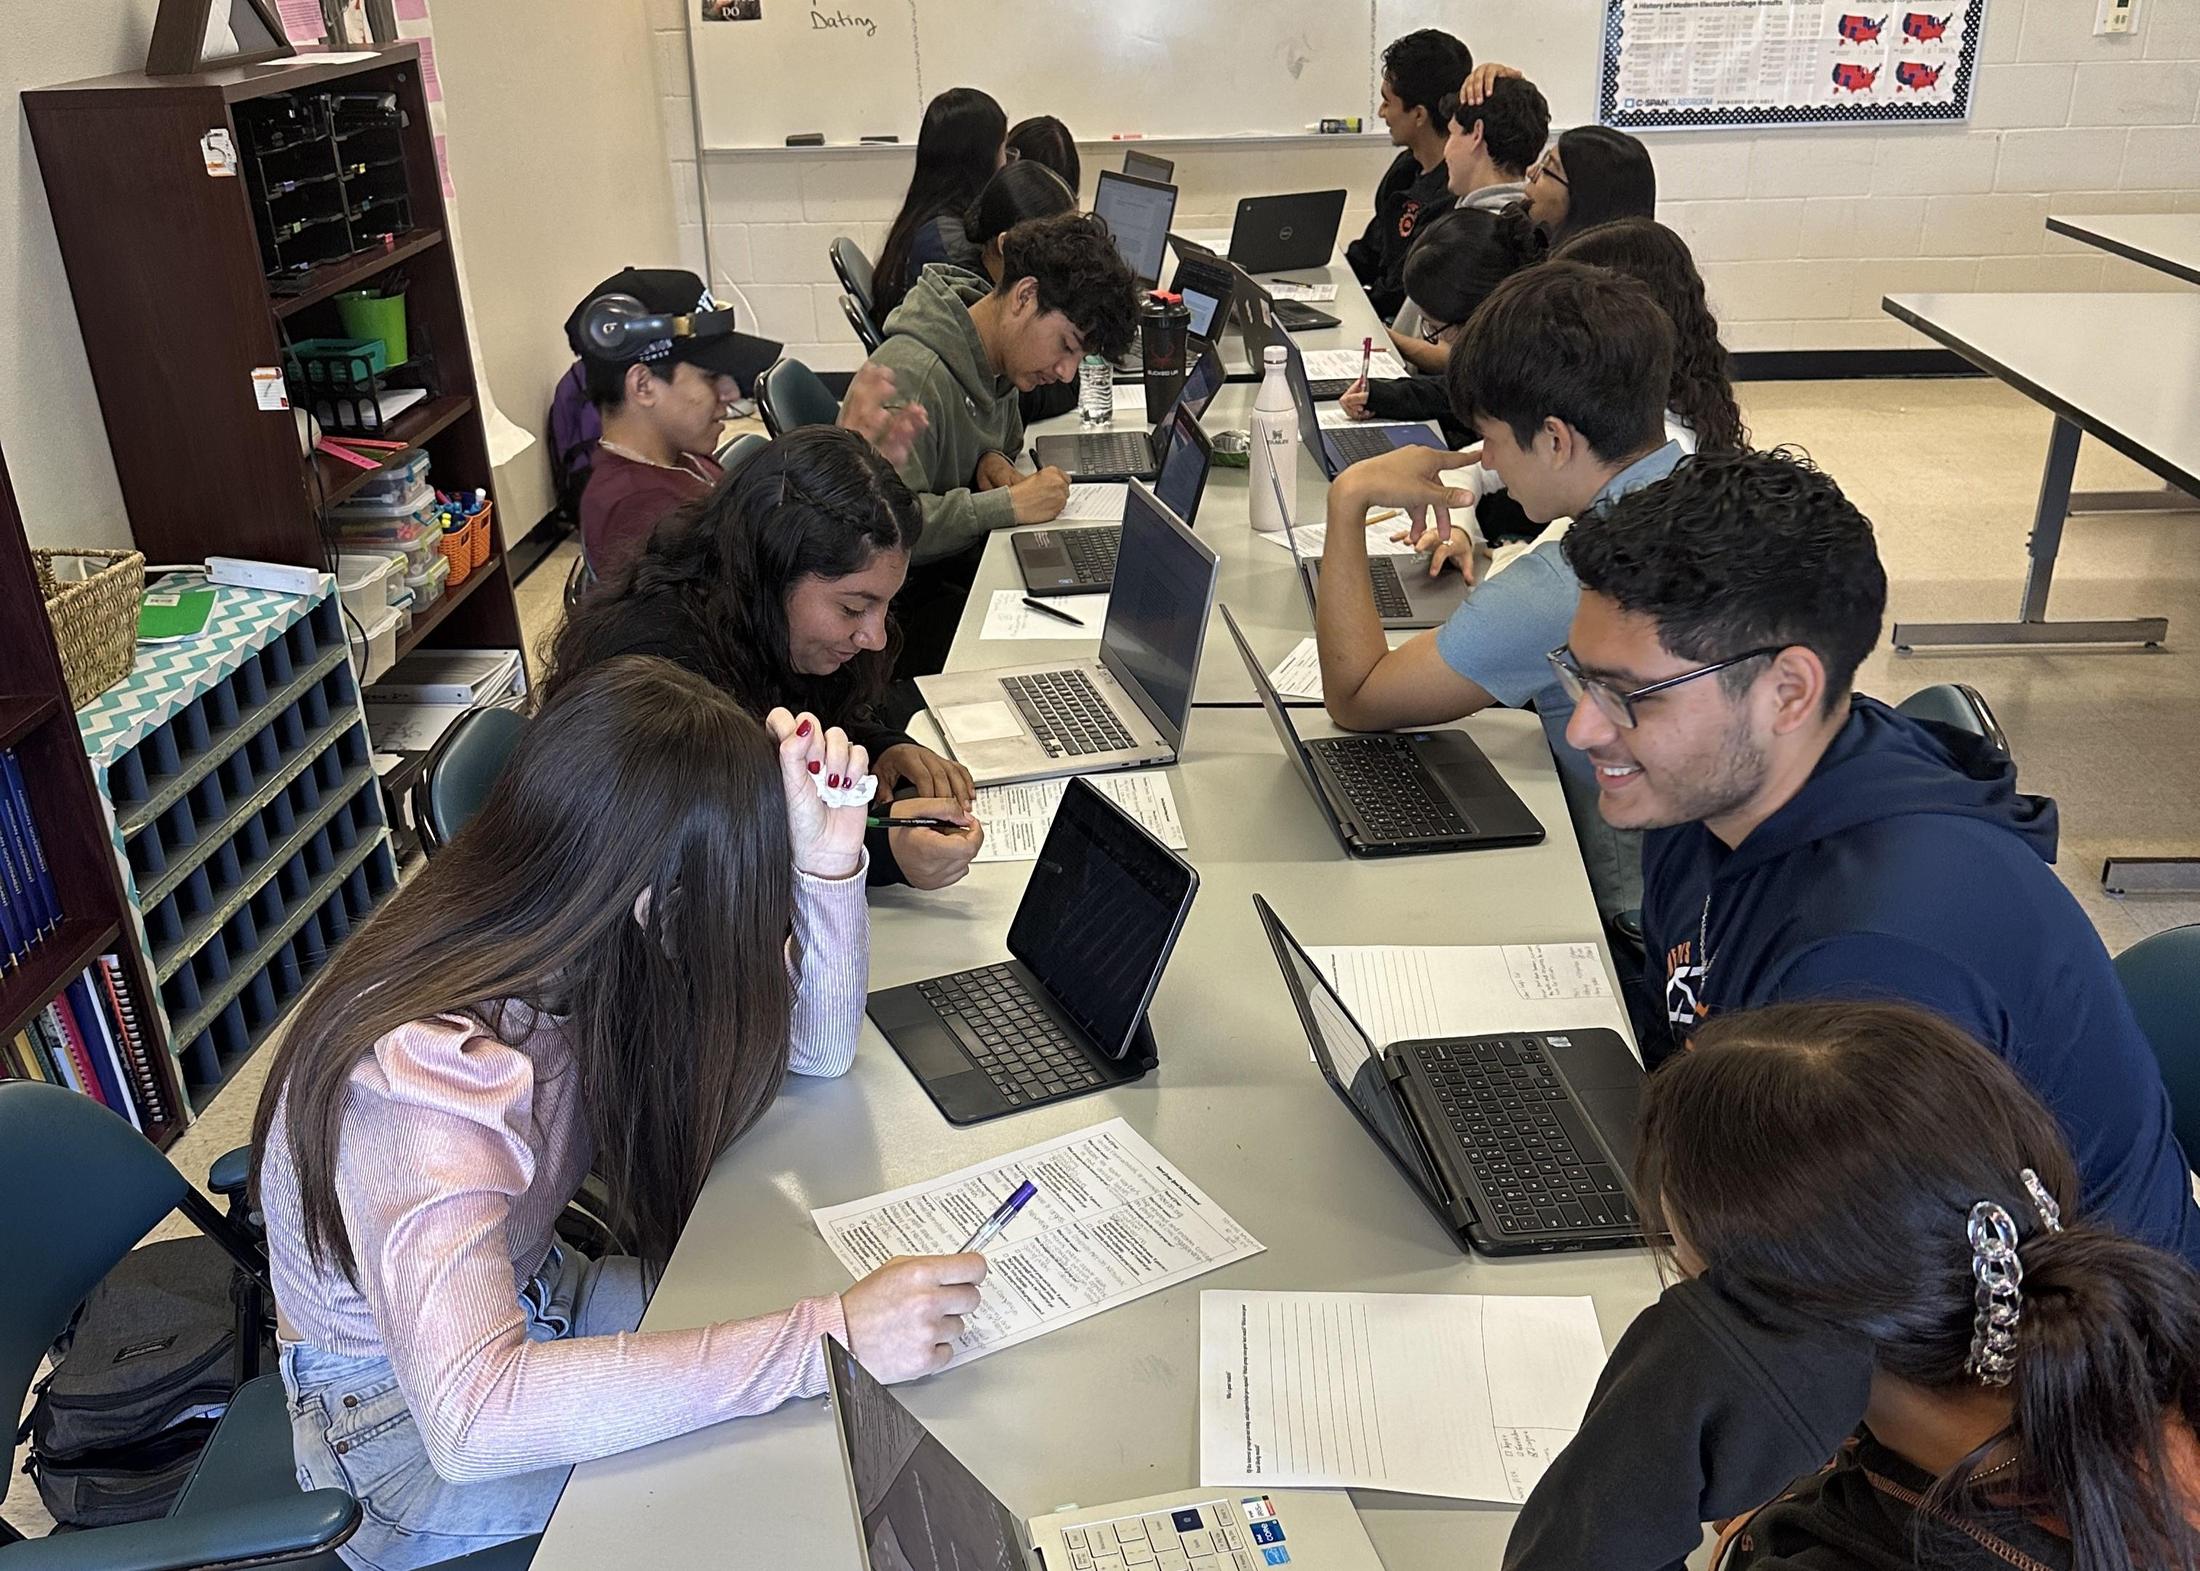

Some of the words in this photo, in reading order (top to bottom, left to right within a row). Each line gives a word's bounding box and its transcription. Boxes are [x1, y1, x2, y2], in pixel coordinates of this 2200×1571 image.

[722, 7, 740, 17] DO
[1638, 2, 1664, 10] History
[810, 10, 877, 37] Dating
[14, 835, 35, 883] GOVERNMENT
[28, 826, 47, 873] GOVERNMENT
